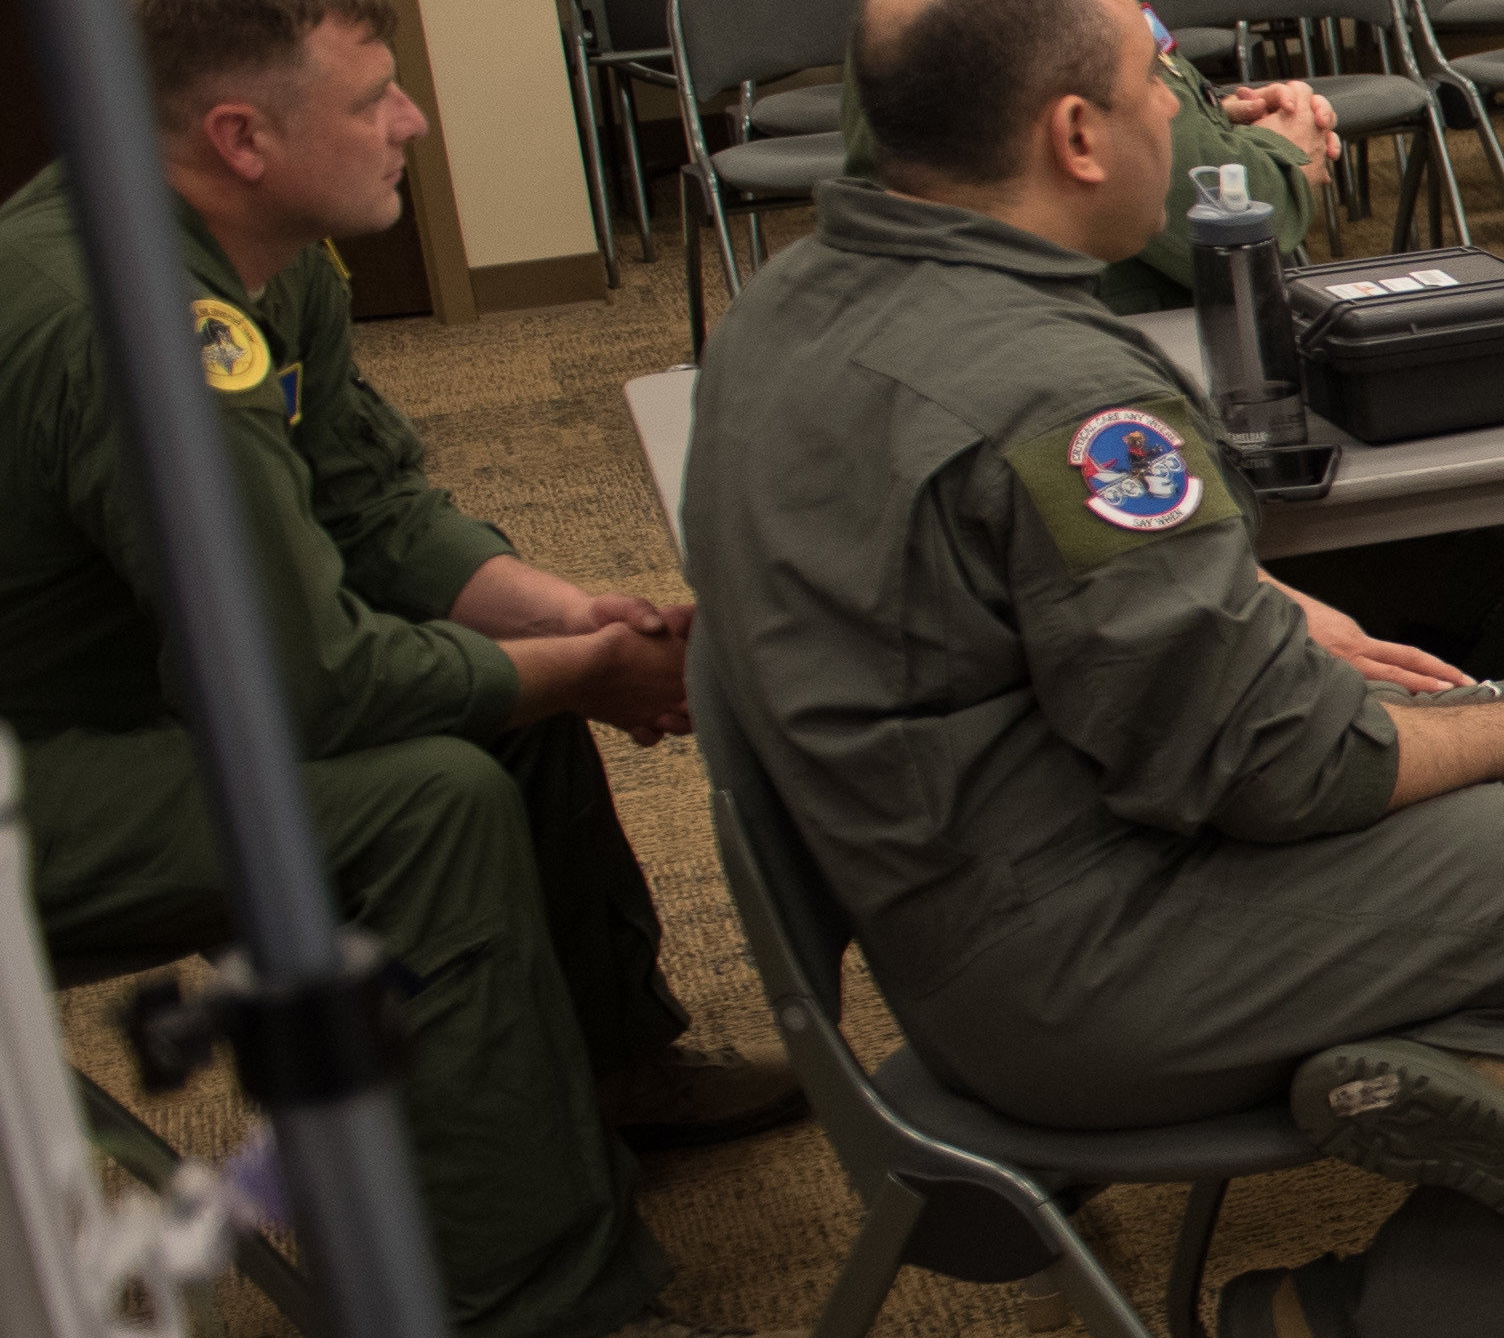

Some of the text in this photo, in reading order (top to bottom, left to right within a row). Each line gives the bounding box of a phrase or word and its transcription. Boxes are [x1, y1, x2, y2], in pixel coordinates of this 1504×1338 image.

[1071, 423, 1097, 461] CRITICAL
[1097, 412, 1119, 427] CARE
[1133, 510, 1184, 528] SAY WHEN
